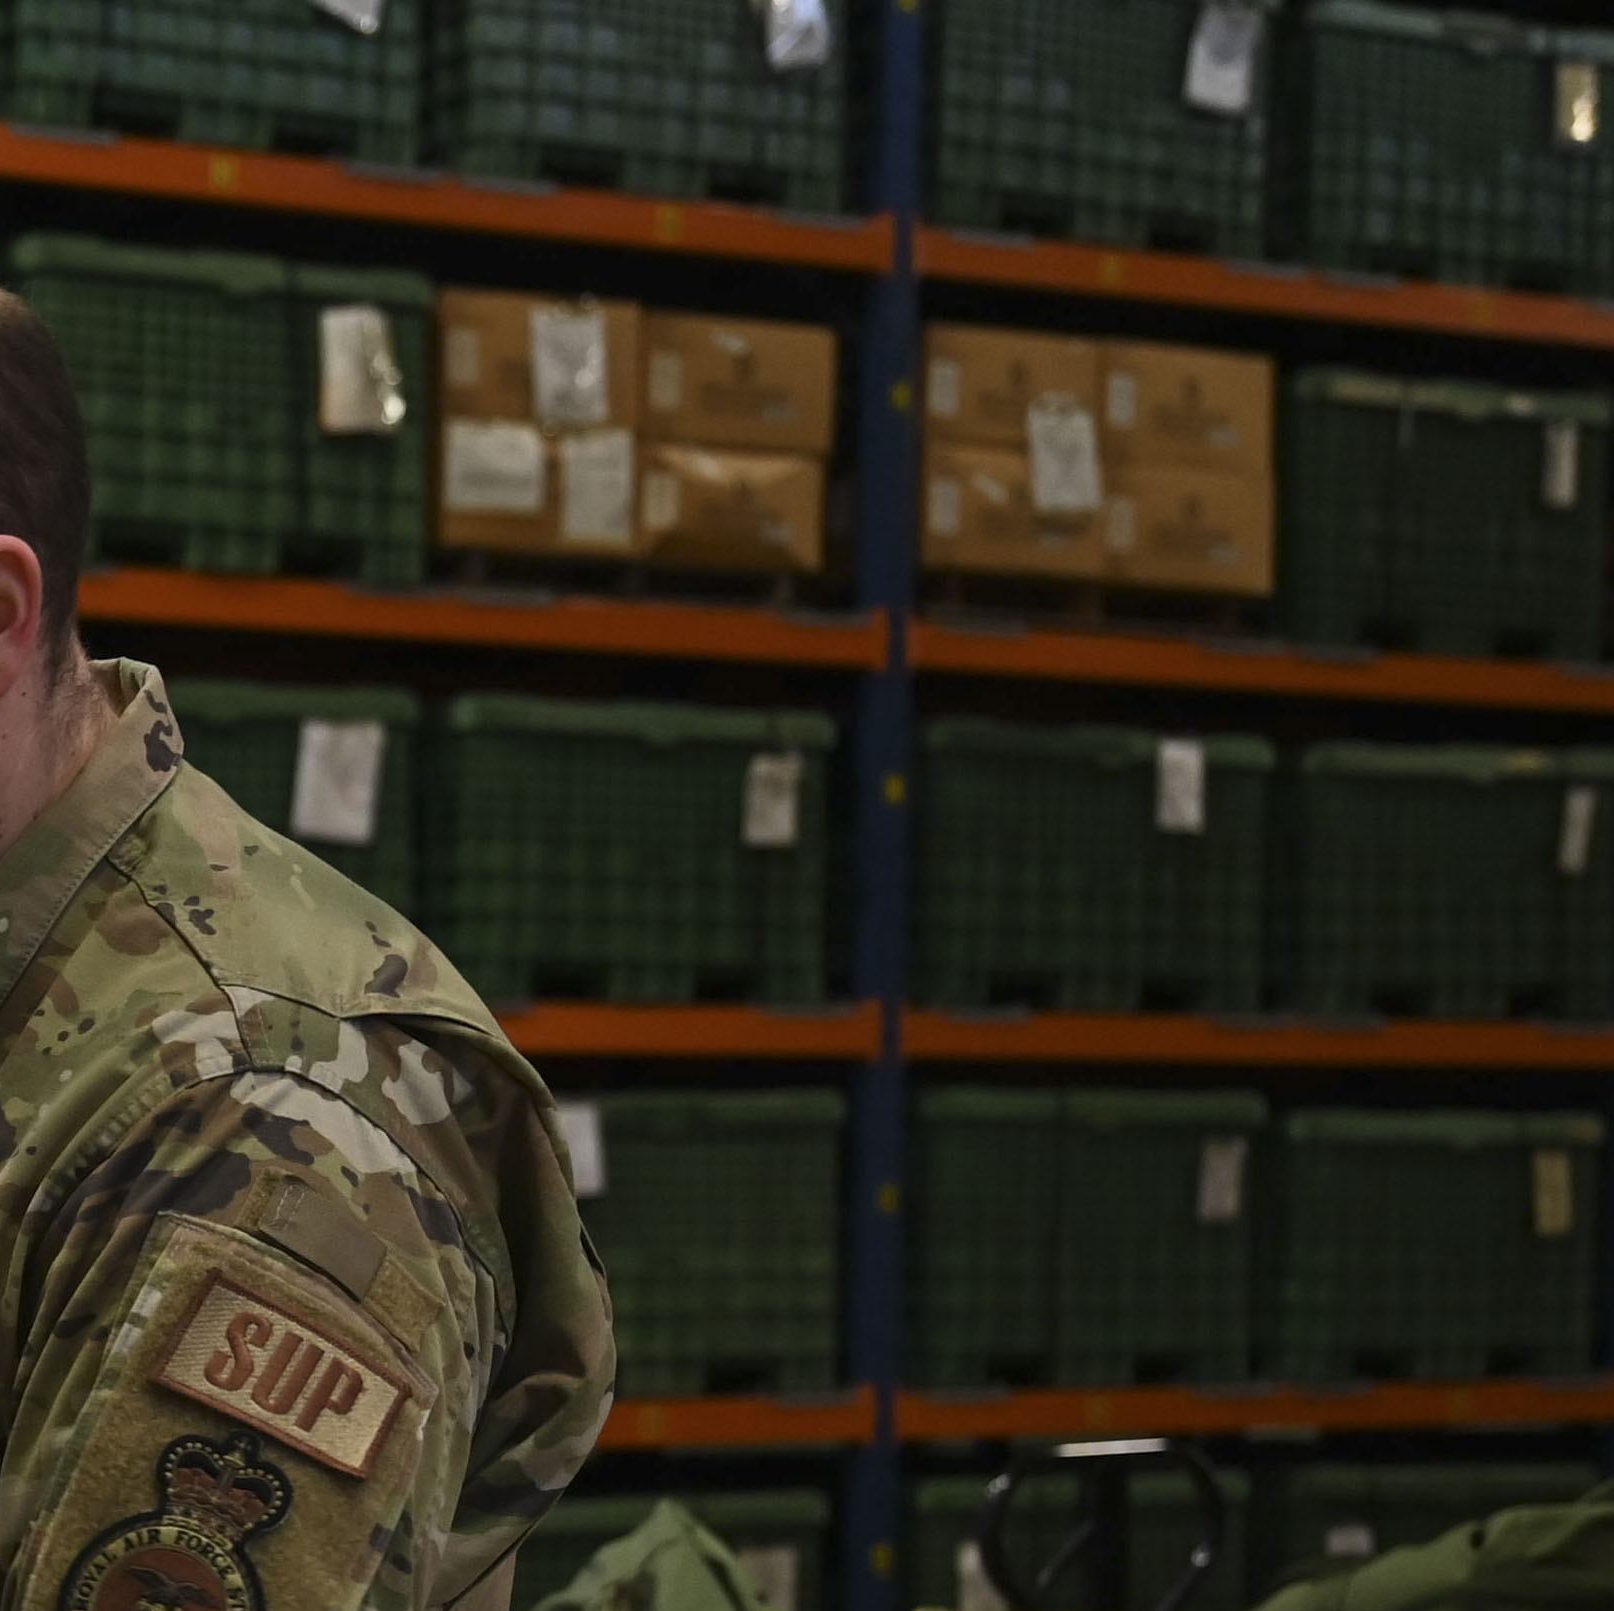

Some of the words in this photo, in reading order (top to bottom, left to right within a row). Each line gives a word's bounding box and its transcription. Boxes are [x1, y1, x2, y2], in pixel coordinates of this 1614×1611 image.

[202, 1310, 365, 1433] SUP
[123, 1528, 162, 1553] AIR
[173, 1529, 234, 1581] FORCE
